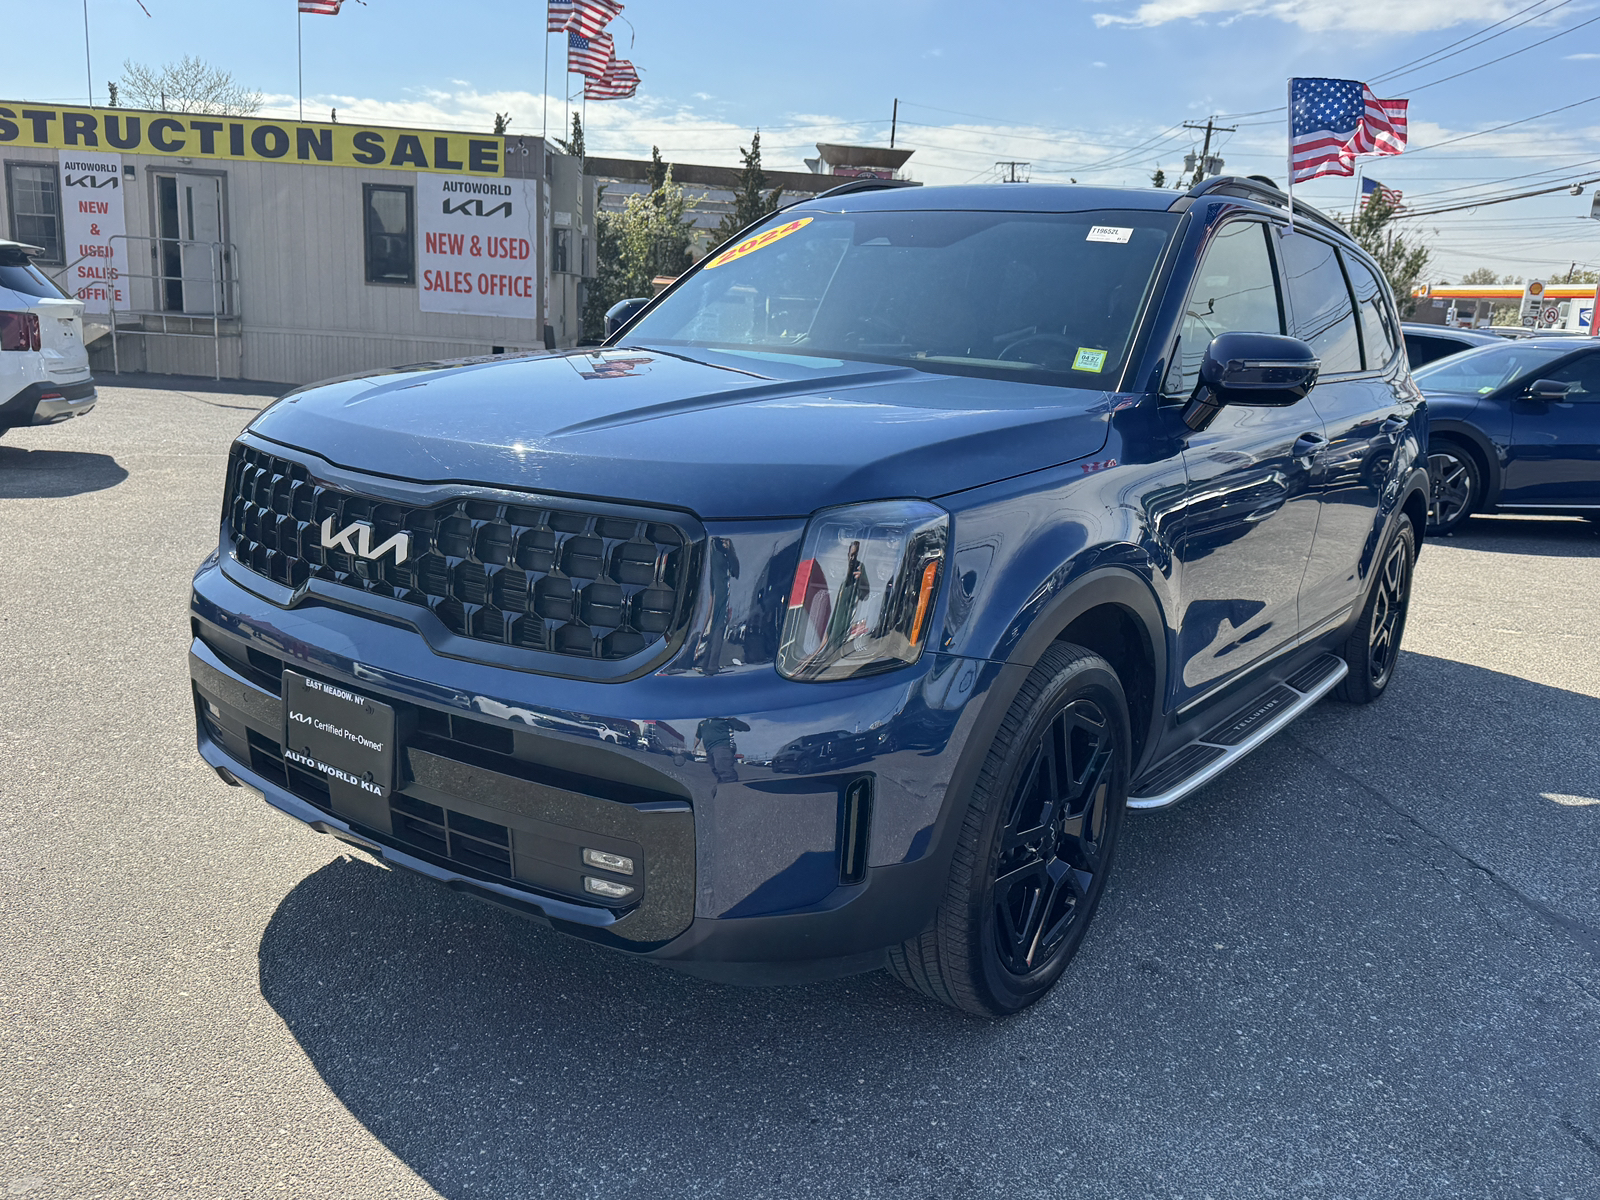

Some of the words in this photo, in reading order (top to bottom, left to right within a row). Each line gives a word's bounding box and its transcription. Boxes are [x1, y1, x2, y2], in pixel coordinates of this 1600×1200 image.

[352, 131, 499, 172] SALE
[64, 161, 117, 173] AUTOWORLD
[65, 173, 119, 190] KIA
[442, 180, 512, 196] AUTOWORLD
[78, 200, 109, 214] NEW
[442, 197, 513, 219] KIA
[90, 223, 101, 236] &
[716, 220, 801, 266] 2024
[79, 244, 114, 258] USED
[425, 231, 465, 256] NEW
[469, 234, 482, 257] &
[487, 236, 530, 260] USED
[78, 287, 122, 302] OFFIE
[423, 269, 473, 294] SALES
[477, 273, 533, 298] OFFICE
[321, 513, 411, 566] KIA
[305, 678, 323, 691] EAST
[354, 695, 365, 706] NY
[289, 710, 313, 726] KIA
[314, 718, 343, 738] Certified
[1233, 699, 1279, 731] TELLURIDE
[284, 750, 315, 768] AUTO
[317, 761, 359, 786] WORLD
[361, 780, 382, 797] KIA
